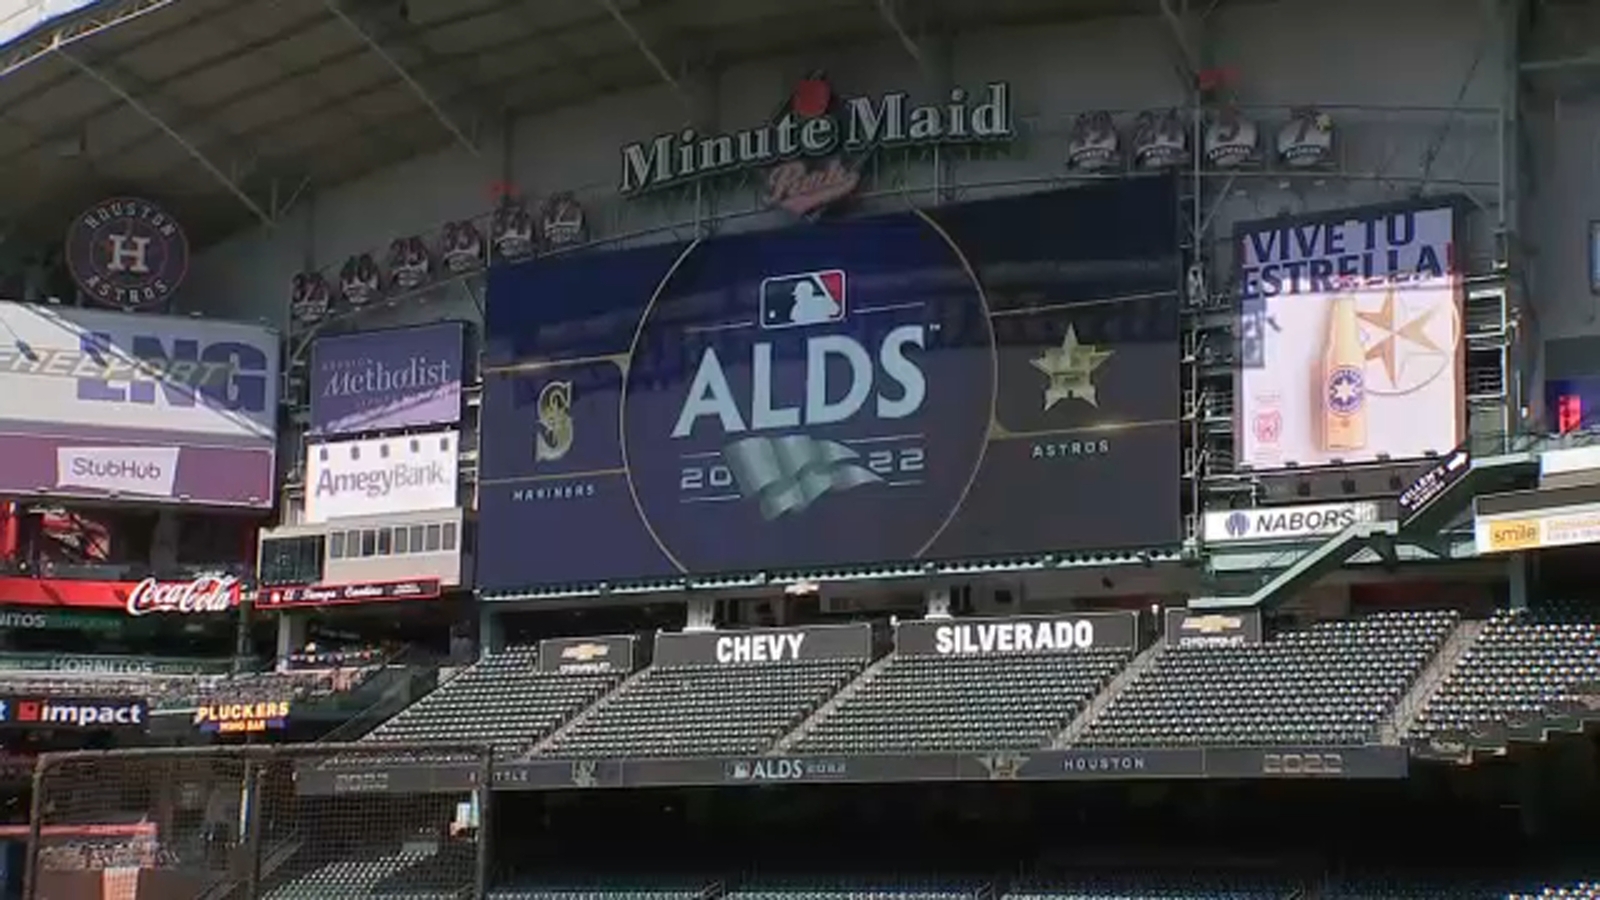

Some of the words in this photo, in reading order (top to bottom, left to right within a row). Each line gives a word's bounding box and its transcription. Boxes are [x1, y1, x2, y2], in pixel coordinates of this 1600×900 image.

[618, 113, 838, 194] Minute
[847, 82, 1012, 144] Maid
[86, 202, 177, 238] HOUSTON
[1248, 222, 1345, 263] VIVE
[1360, 211, 1416, 248] TU
[107, 234, 150, 274] H
[1241, 245, 1443, 299] ESTRELLA
[86, 276, 169, 303] ASTROS
[78, 331, 267, 412] LNG
[321, 356, 451, 397] Methodist
[671, 325, 927, 438] ALDS
[1032, 439, 1110, 459] ASTROS
[72, 456, 161, 481] StubHub
[513, 483, 596, 502] MARINERS
[1257, 509, 1355, 532] NABORS
[1494, 524, 1537, 543] smile
[716, 633, 806, 663] CHEVY
[935, 619, 1094, 654] SILVERADO
[51, 656, 154, 674] HORNITOS
[41, 702, 142, 727] impact
[197, 702, 290, 721] PLUCKERS
[752, 758, 804, 779] ALDS
[1064, 756, 1146, 772] HOUSTON
